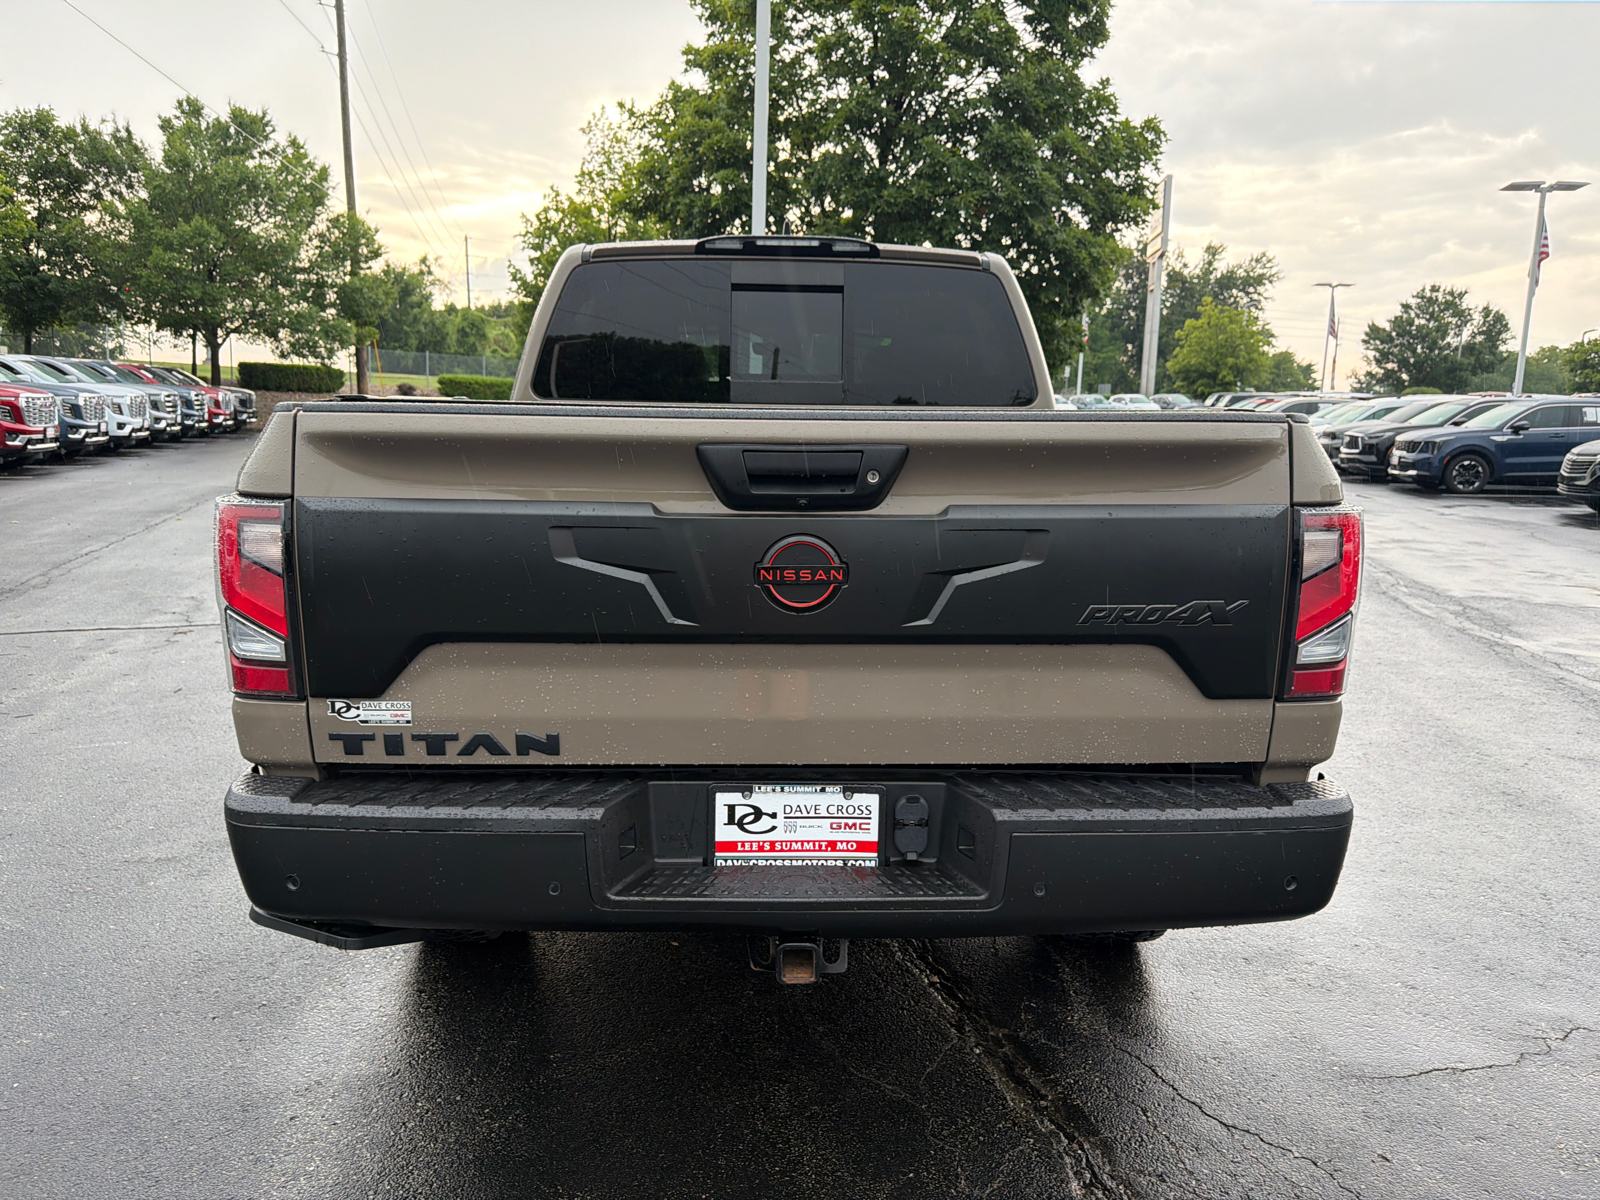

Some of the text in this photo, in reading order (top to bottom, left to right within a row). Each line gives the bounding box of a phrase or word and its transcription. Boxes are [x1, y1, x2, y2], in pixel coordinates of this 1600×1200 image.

[760, 569, 843, 581] NISSAN
[328, 732, 560, 756] TITAN
[783, 804, 872, 816] DAVE CROSS
[723, 803, 778, 834] DC
[829, 821, 871, 831] GMC
[737, 842, 857, 852] LEE'S SUMMIT, MO
[716, 859, 876, 867] DAVCROSSMOTORSCOM
